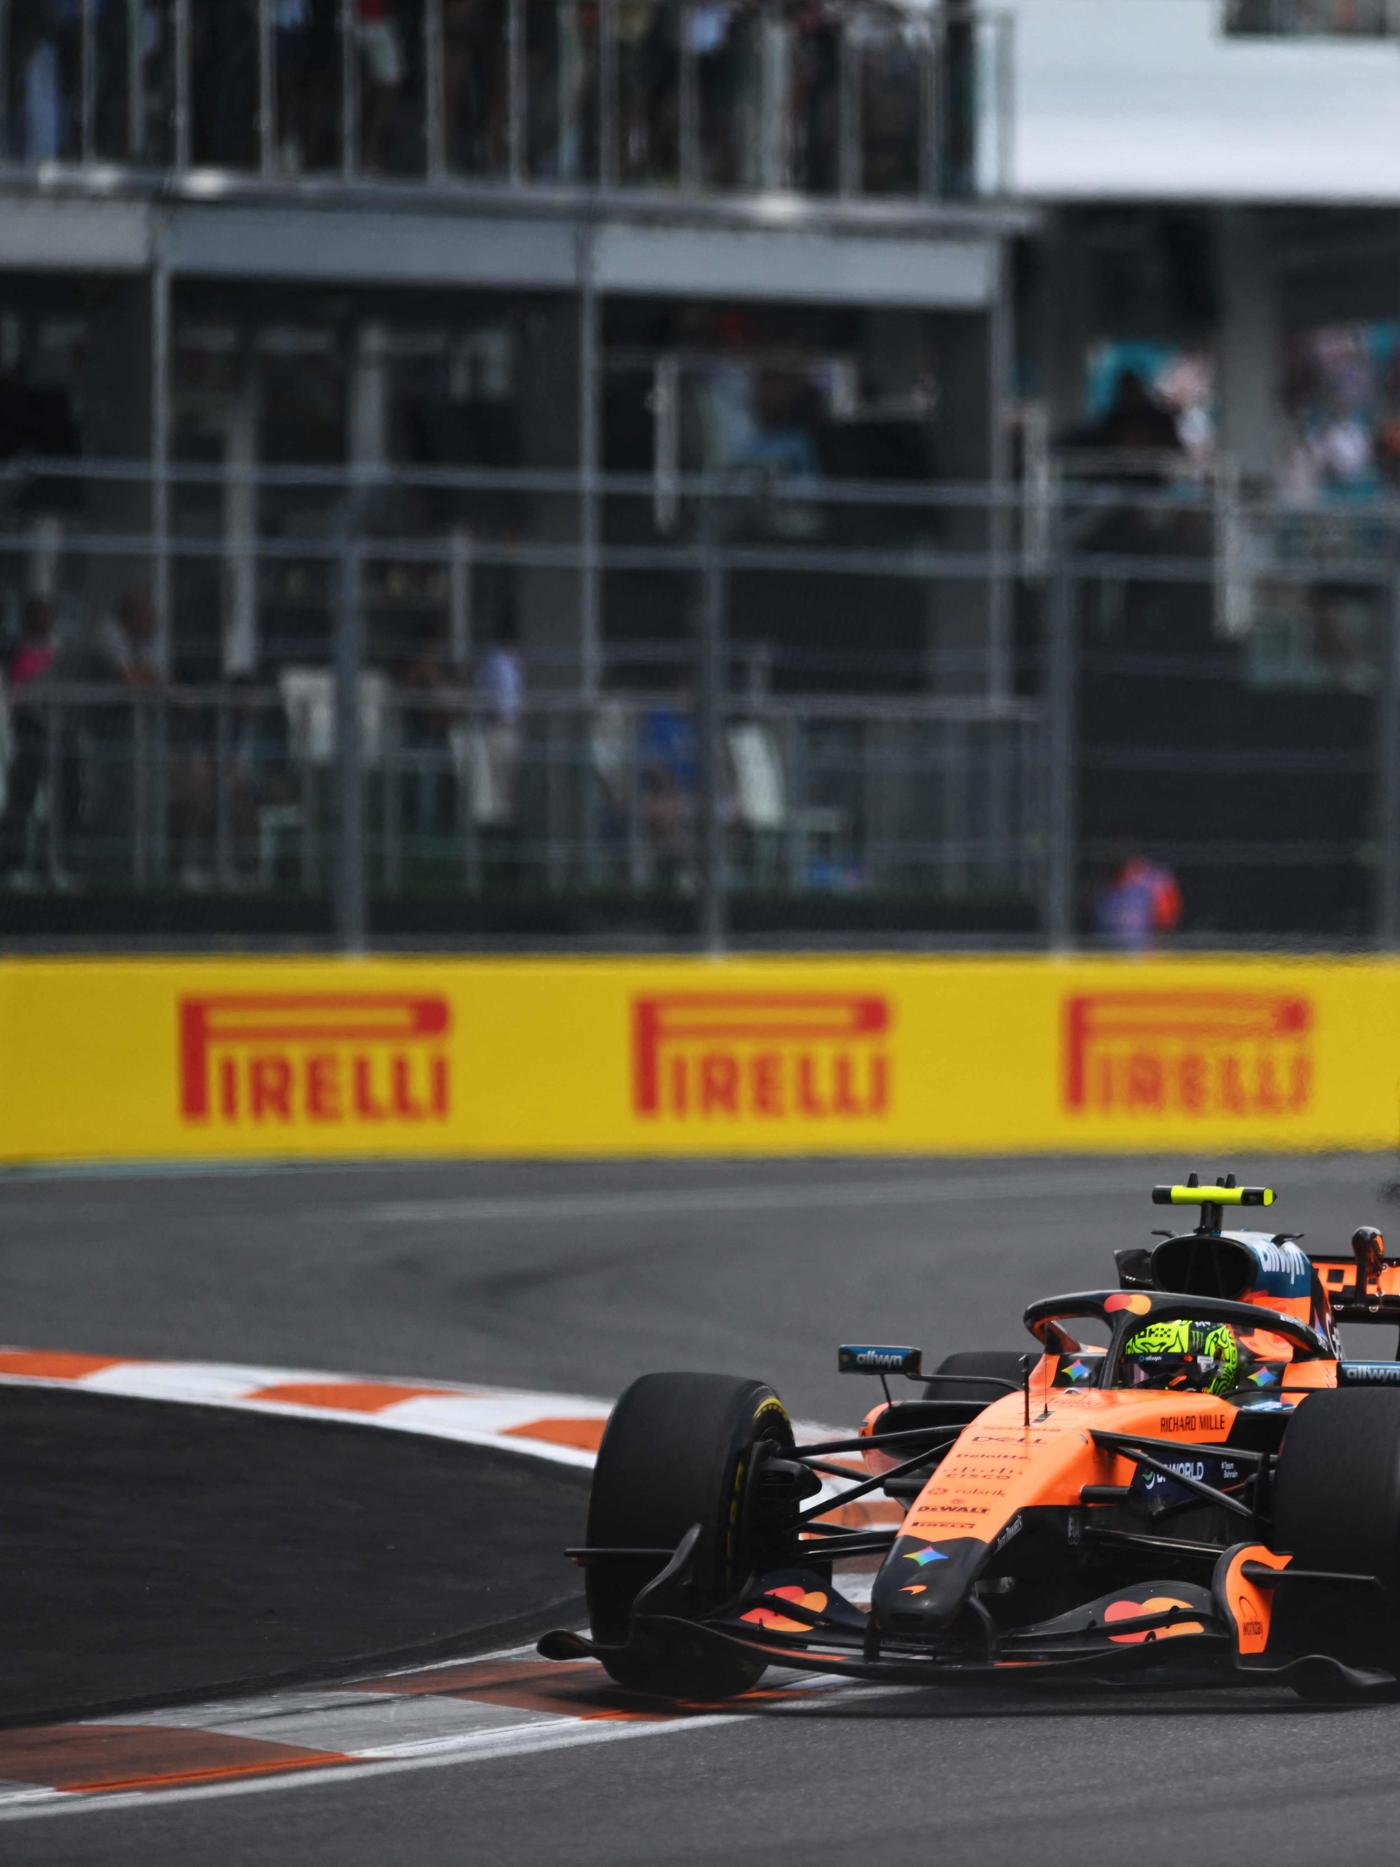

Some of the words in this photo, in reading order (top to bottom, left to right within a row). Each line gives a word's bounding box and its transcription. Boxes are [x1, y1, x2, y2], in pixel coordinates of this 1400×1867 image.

[180, 990, 448, 1120] PIRELLI
[632, 990, 888, 1118] PIRELLI
[1062, 989, 1308, 1114] PIRELLI
[856, 1351, 902, 1368] allwyn
[1346, 1365, 1400, 1382] allwyn
[1160, 1415, 1196, 1432] RICHARD
[1199, 1414, 1225, 1430] MILLE
